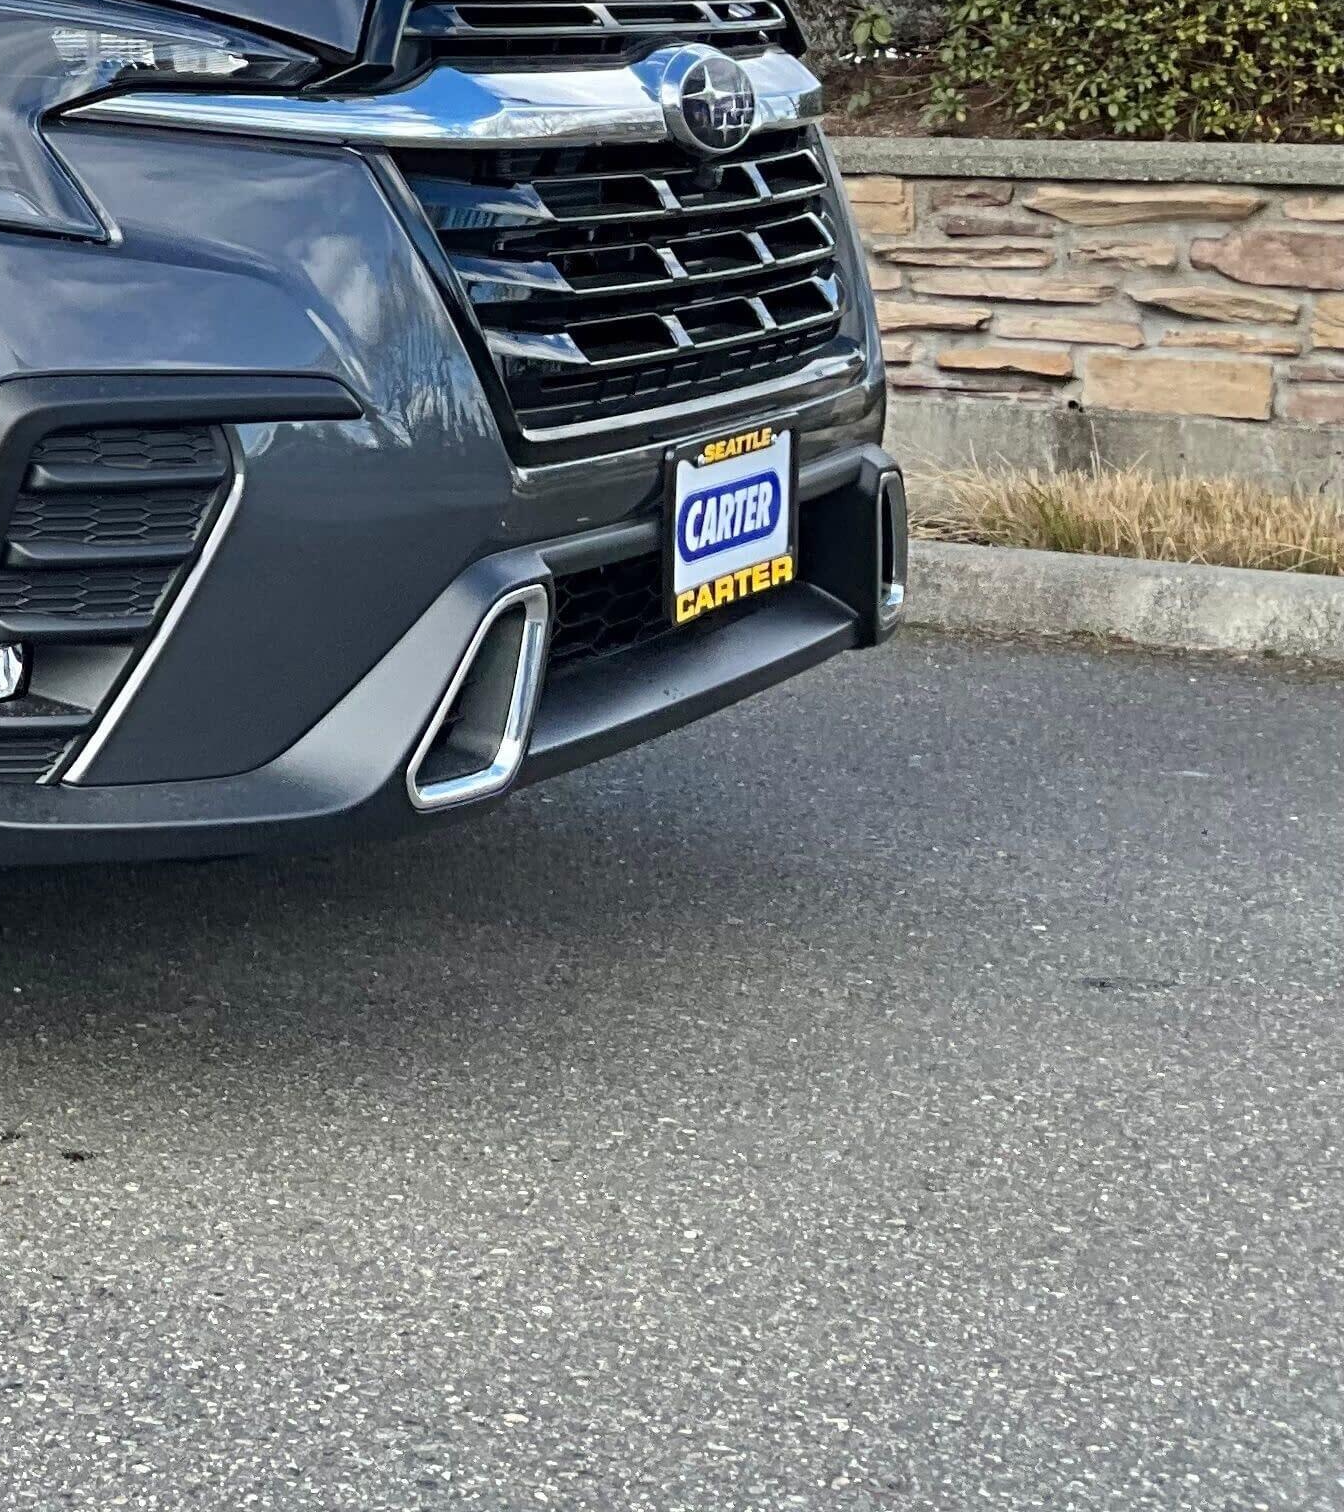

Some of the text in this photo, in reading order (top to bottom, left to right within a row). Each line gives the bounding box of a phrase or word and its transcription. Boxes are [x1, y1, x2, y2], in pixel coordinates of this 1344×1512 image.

[703, 428, 772, 463] SEATTLE
[685, 481, 773, 553] CARTER
[675, 555, 794, 623] CARTER
